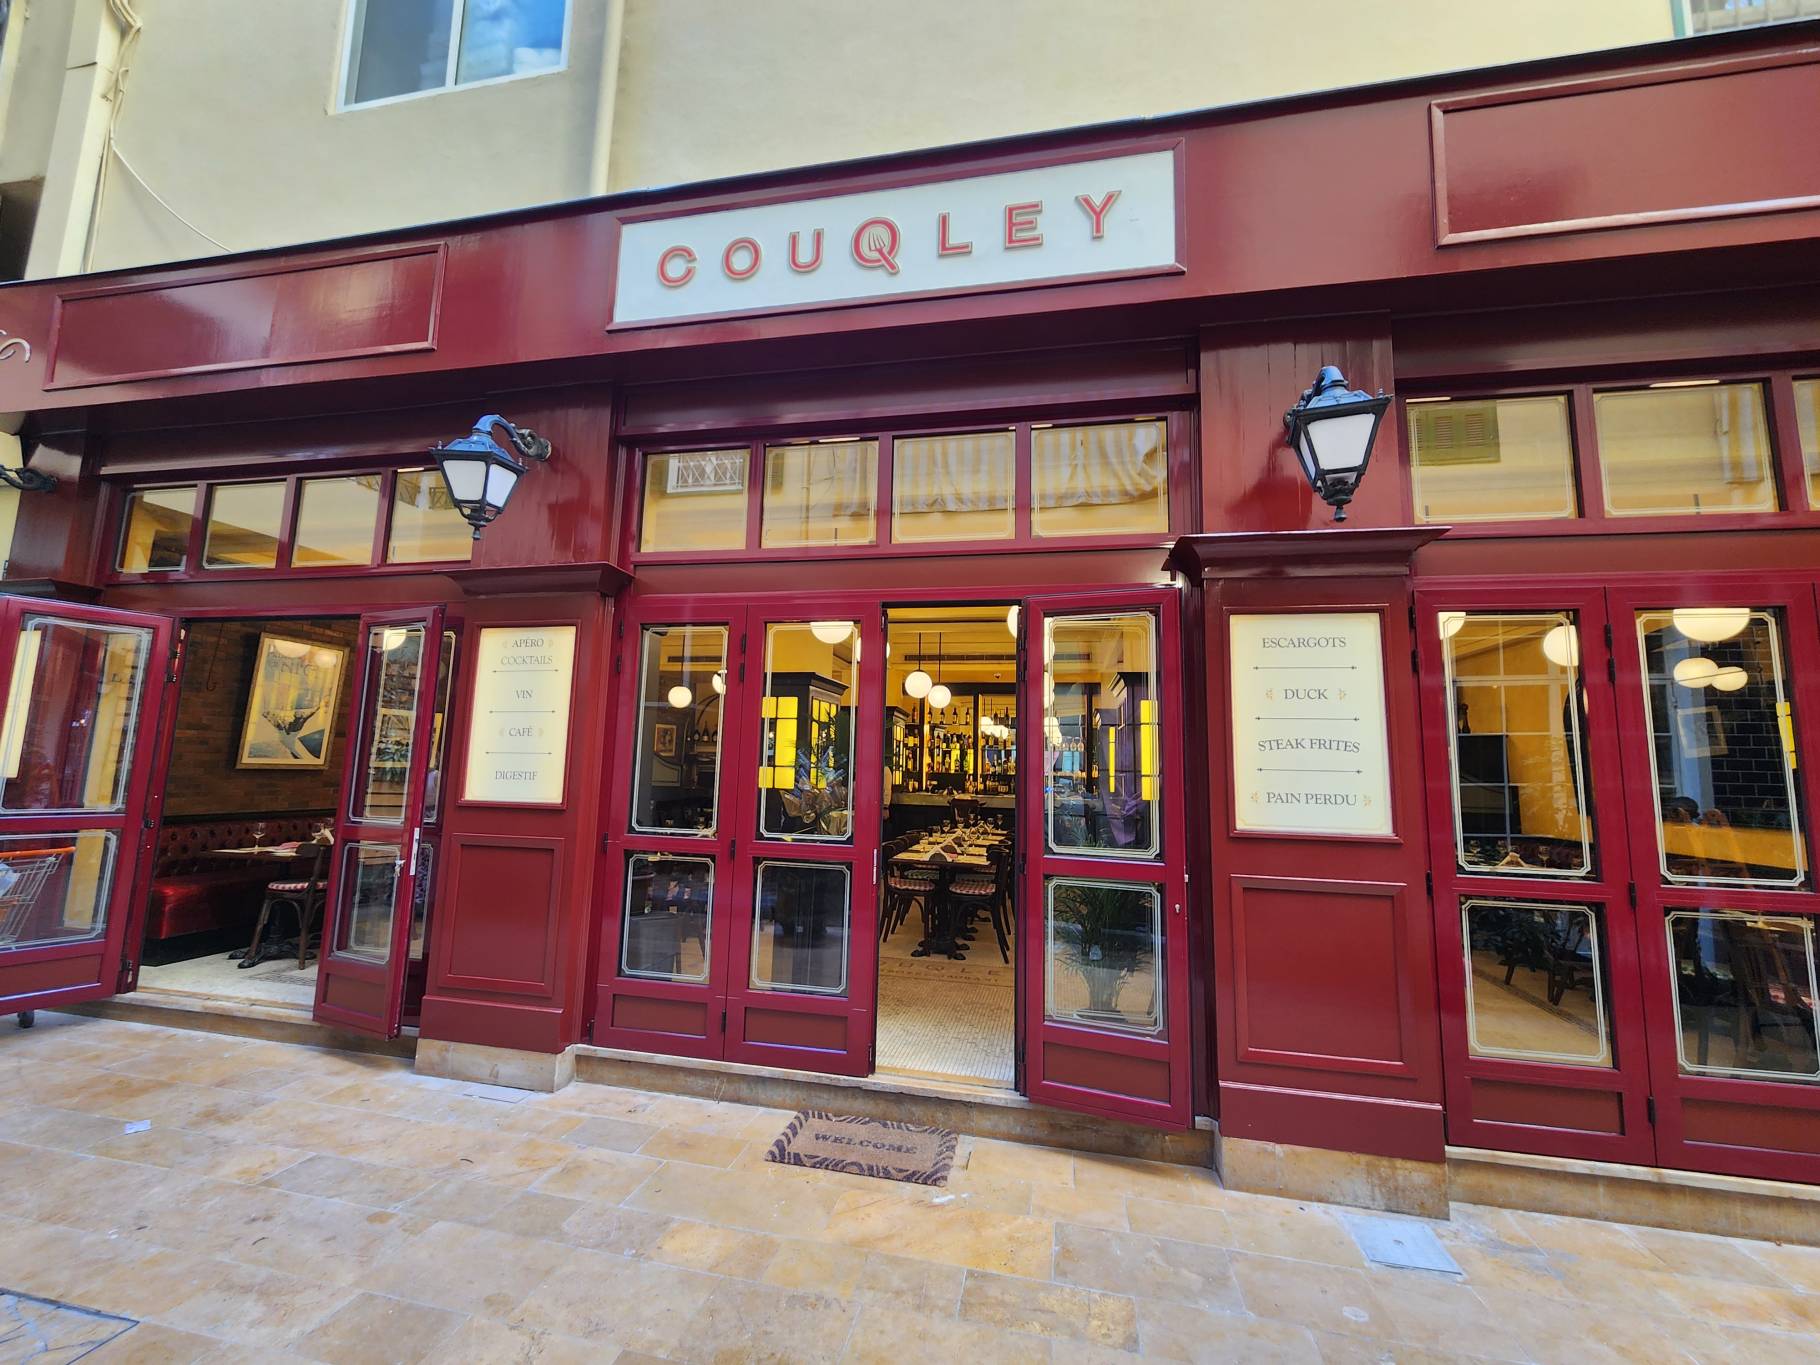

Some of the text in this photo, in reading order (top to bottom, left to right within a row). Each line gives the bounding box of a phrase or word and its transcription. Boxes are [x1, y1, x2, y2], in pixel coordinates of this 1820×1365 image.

[657, 190, 1121, 288] COUQLEY
[511, 637, 544, 648] APÉRO
[1262, 637, 1347, 649] ESCARGOTS
[500, 655, 553, 666] COCKTAILS
[514, 689, 533, 699] VIN
[1284, 688, 1328, 700] DUCK
[1258, 738, 1361, 753] STEAK FRITES
[495, 770, 538, 781] DIGESTIF
[1266, 792, 1357, 806] PAIN PERDU
[814, 1132, 918, 1155] WELCOME
